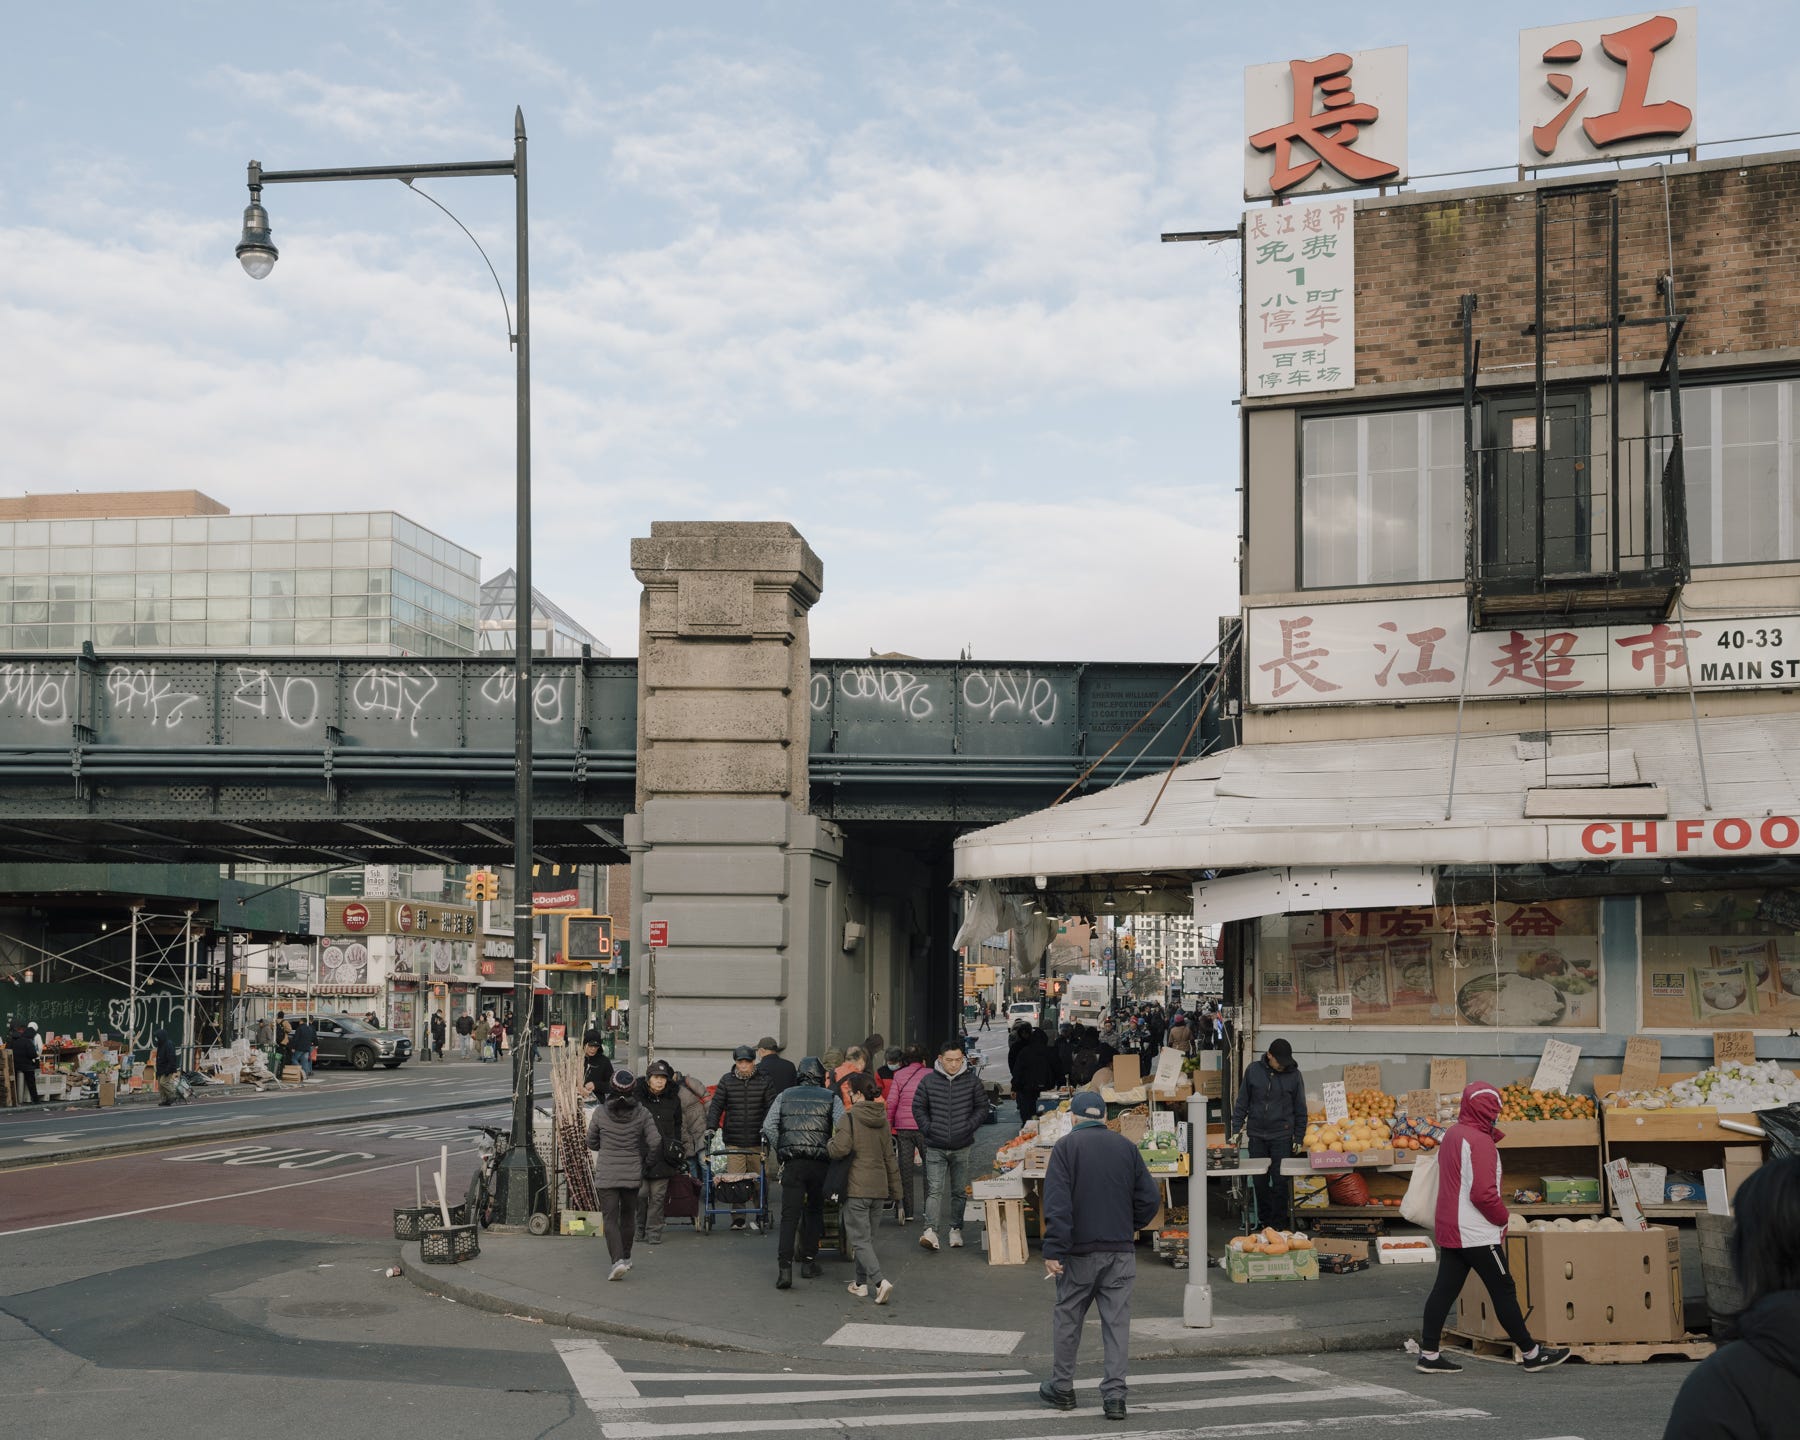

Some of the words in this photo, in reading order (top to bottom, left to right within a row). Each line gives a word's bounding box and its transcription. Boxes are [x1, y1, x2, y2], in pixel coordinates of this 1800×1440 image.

[1249, 15, 1692, 193] 長江
[1251, 204, 1347, 239] 長江超市
[1256, 234, 1337, 264] 免费
[1286, 267, 1305, 285] 1
[1261, 288, 1344, 307] 小时
[1259, 305, 1341, 333] 停车
[1272, 349, 1326, 368] 百利
[1258, 367, 1342, 388] 停车场
[1717, 628, 1783, 649] 40-33
[1259, 616, 1703, 698] 長江超市
[1701, 661, 1762, 681] MAIN
[1770, 660, 1800, 679] ST
[1581, 821, 1658, 855] CH
[1675, 815, 1800, 852] FOO
[532, 893, 576, 904] cDonald's
[161, 1145, 375, 1169] BUS
